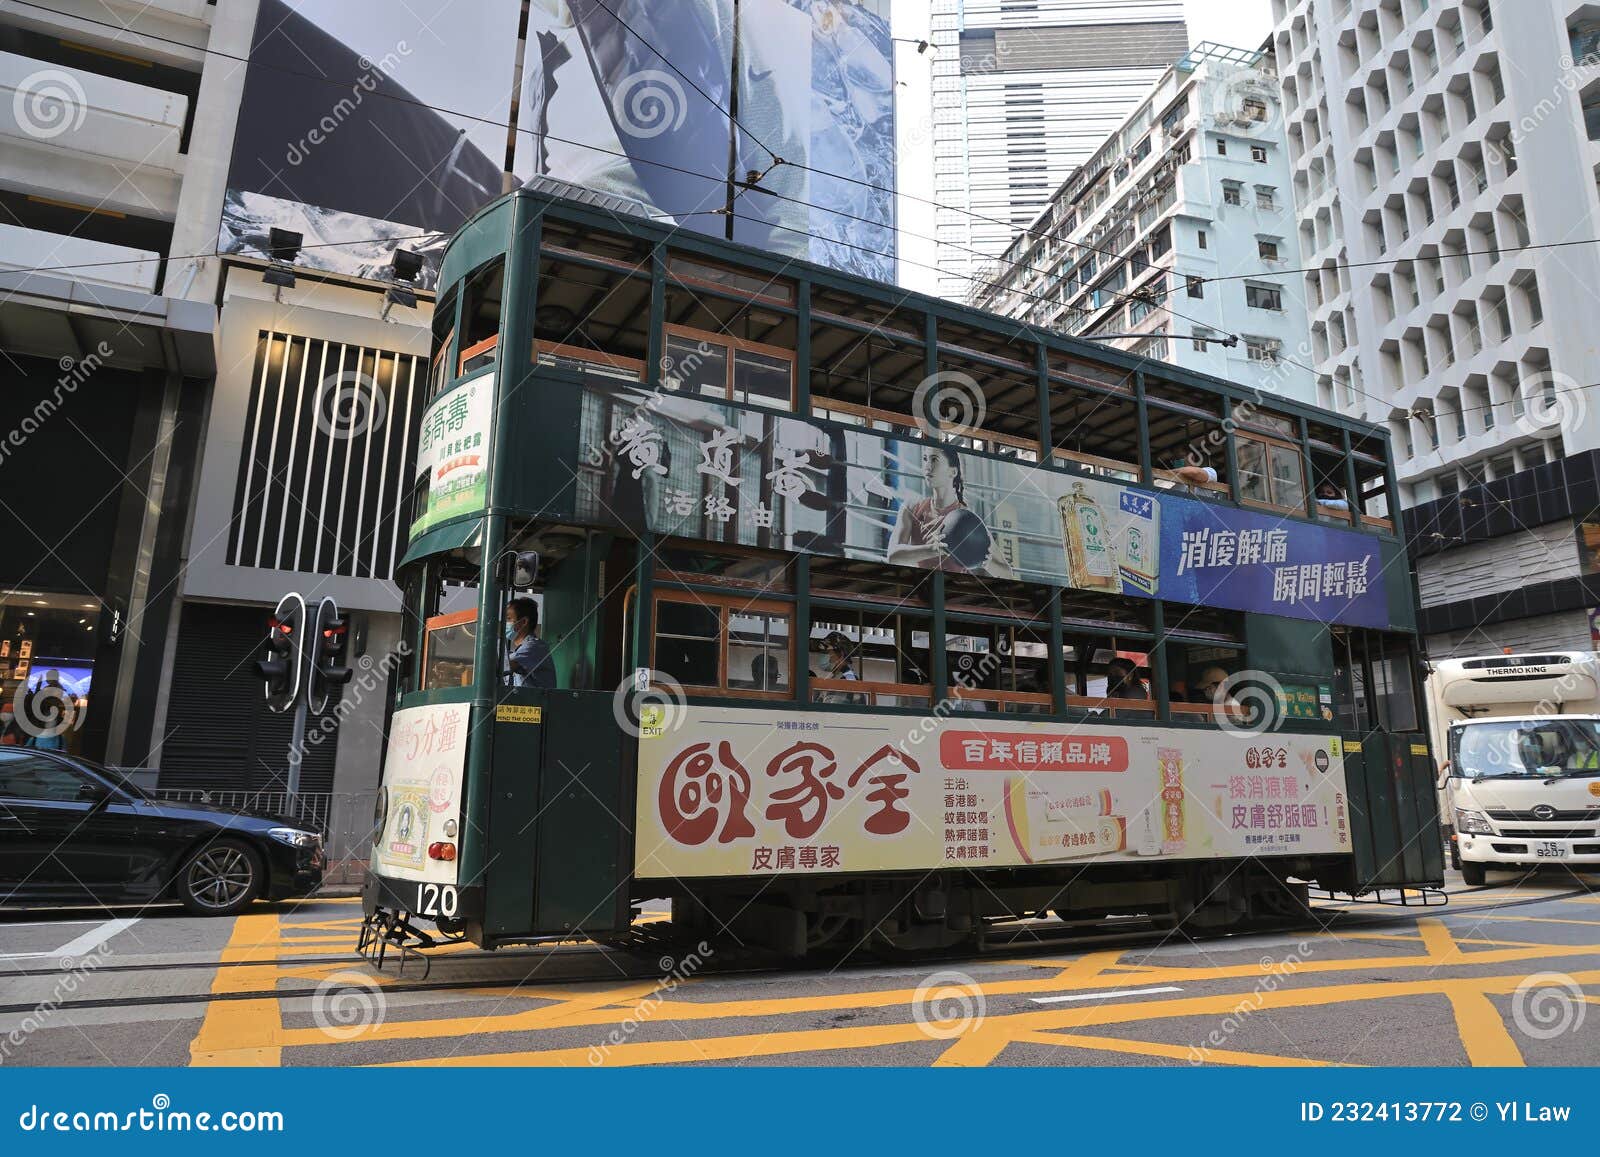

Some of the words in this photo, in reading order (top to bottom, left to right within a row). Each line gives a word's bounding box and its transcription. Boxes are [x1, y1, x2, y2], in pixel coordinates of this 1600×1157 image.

[1177, 527, 1288, 576] 消痠解痛
[1272, 554, 1371, 605] 瞬間輕鬆
[1486, 667, 1524, 675] THERMO
[1525, 666, 1547, 674] KING
[642, 726, 663, 736] EXIT
[961, 738, 1112, 765] 百年信賴品牌
[752, 845, 841, 870] 皮膚專家
[1542, 842, 1557, 850] TS
[416, 883, 458, 917] 120
